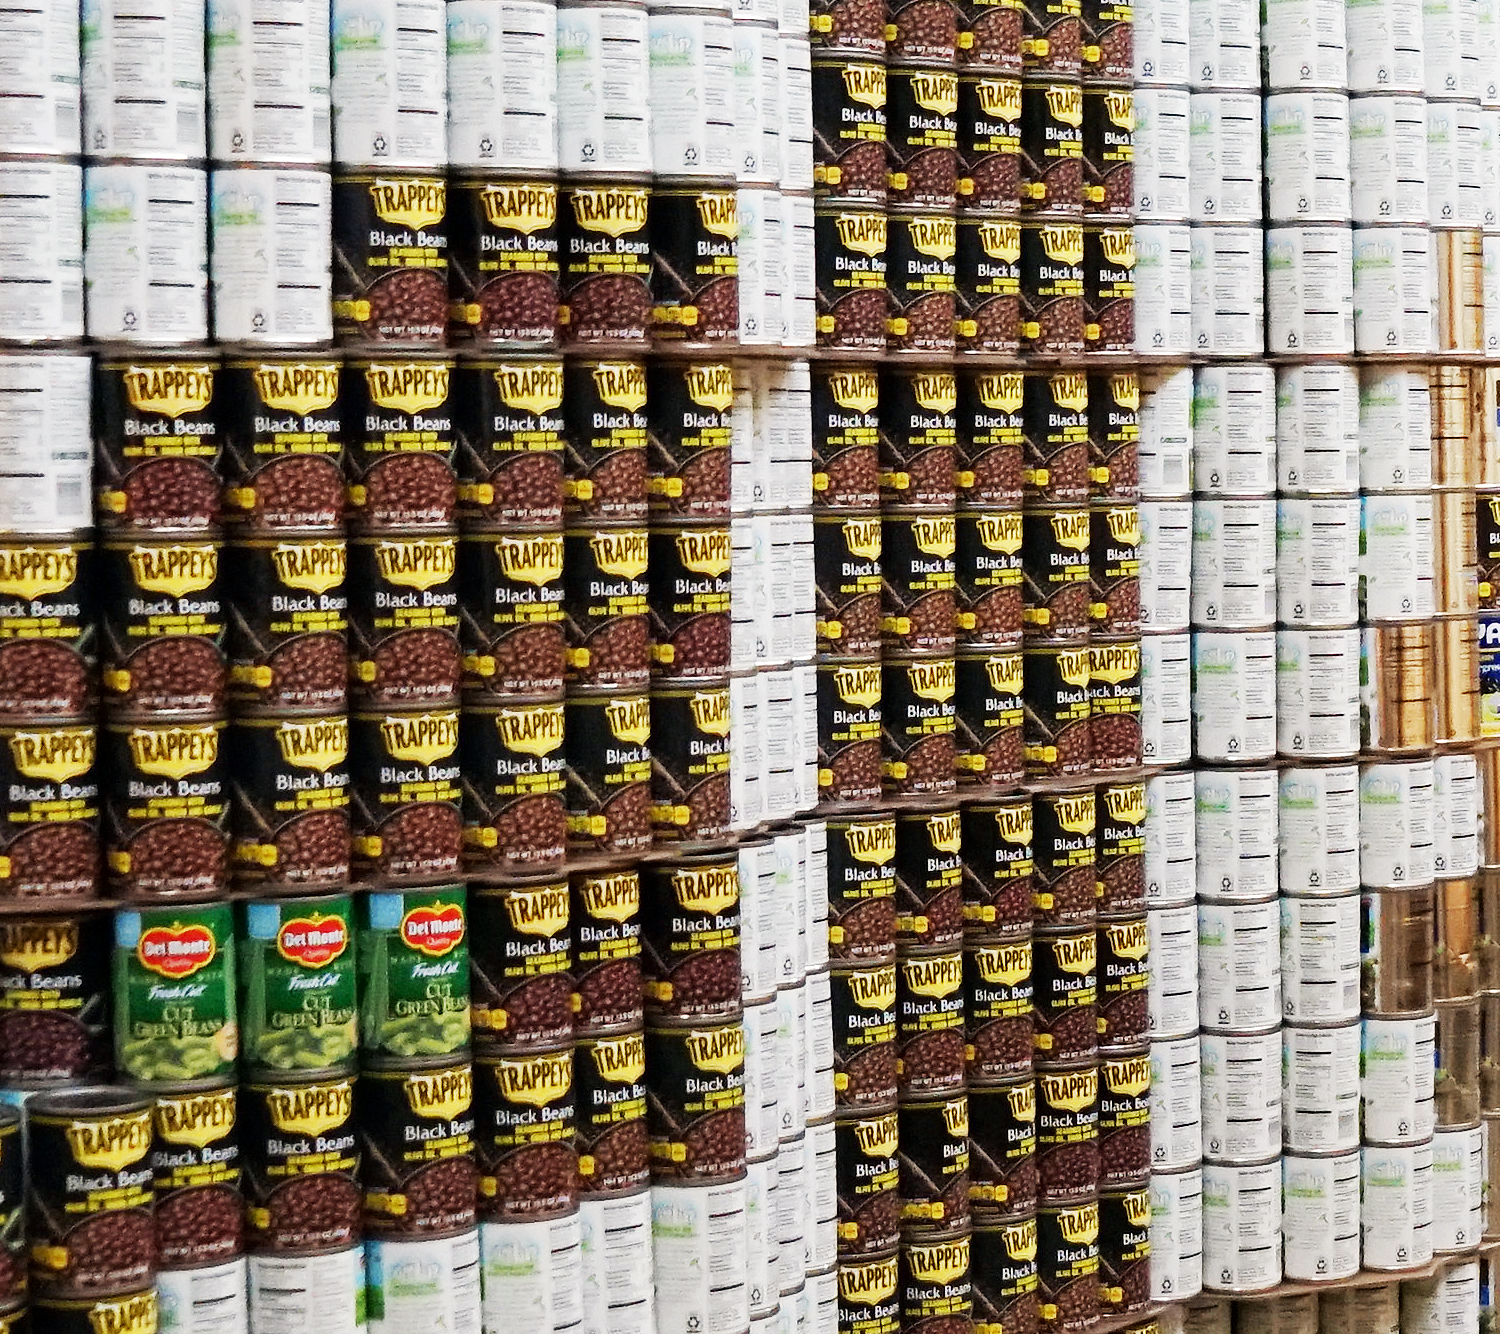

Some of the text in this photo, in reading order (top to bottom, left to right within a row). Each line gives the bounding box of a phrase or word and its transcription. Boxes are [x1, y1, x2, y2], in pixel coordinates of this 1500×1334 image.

[370, 231, 412, 246] Black
[124, 420, 214, 435] Black Beans
[255, 417, 340, 433] Black Beans
[365, 416, 451, 431] Black Beans
[672, 917, 711, 932] Black
[496, 1104, 574, 1125] Black Beans
[267, 1134, 354, 1155] Black Beans
